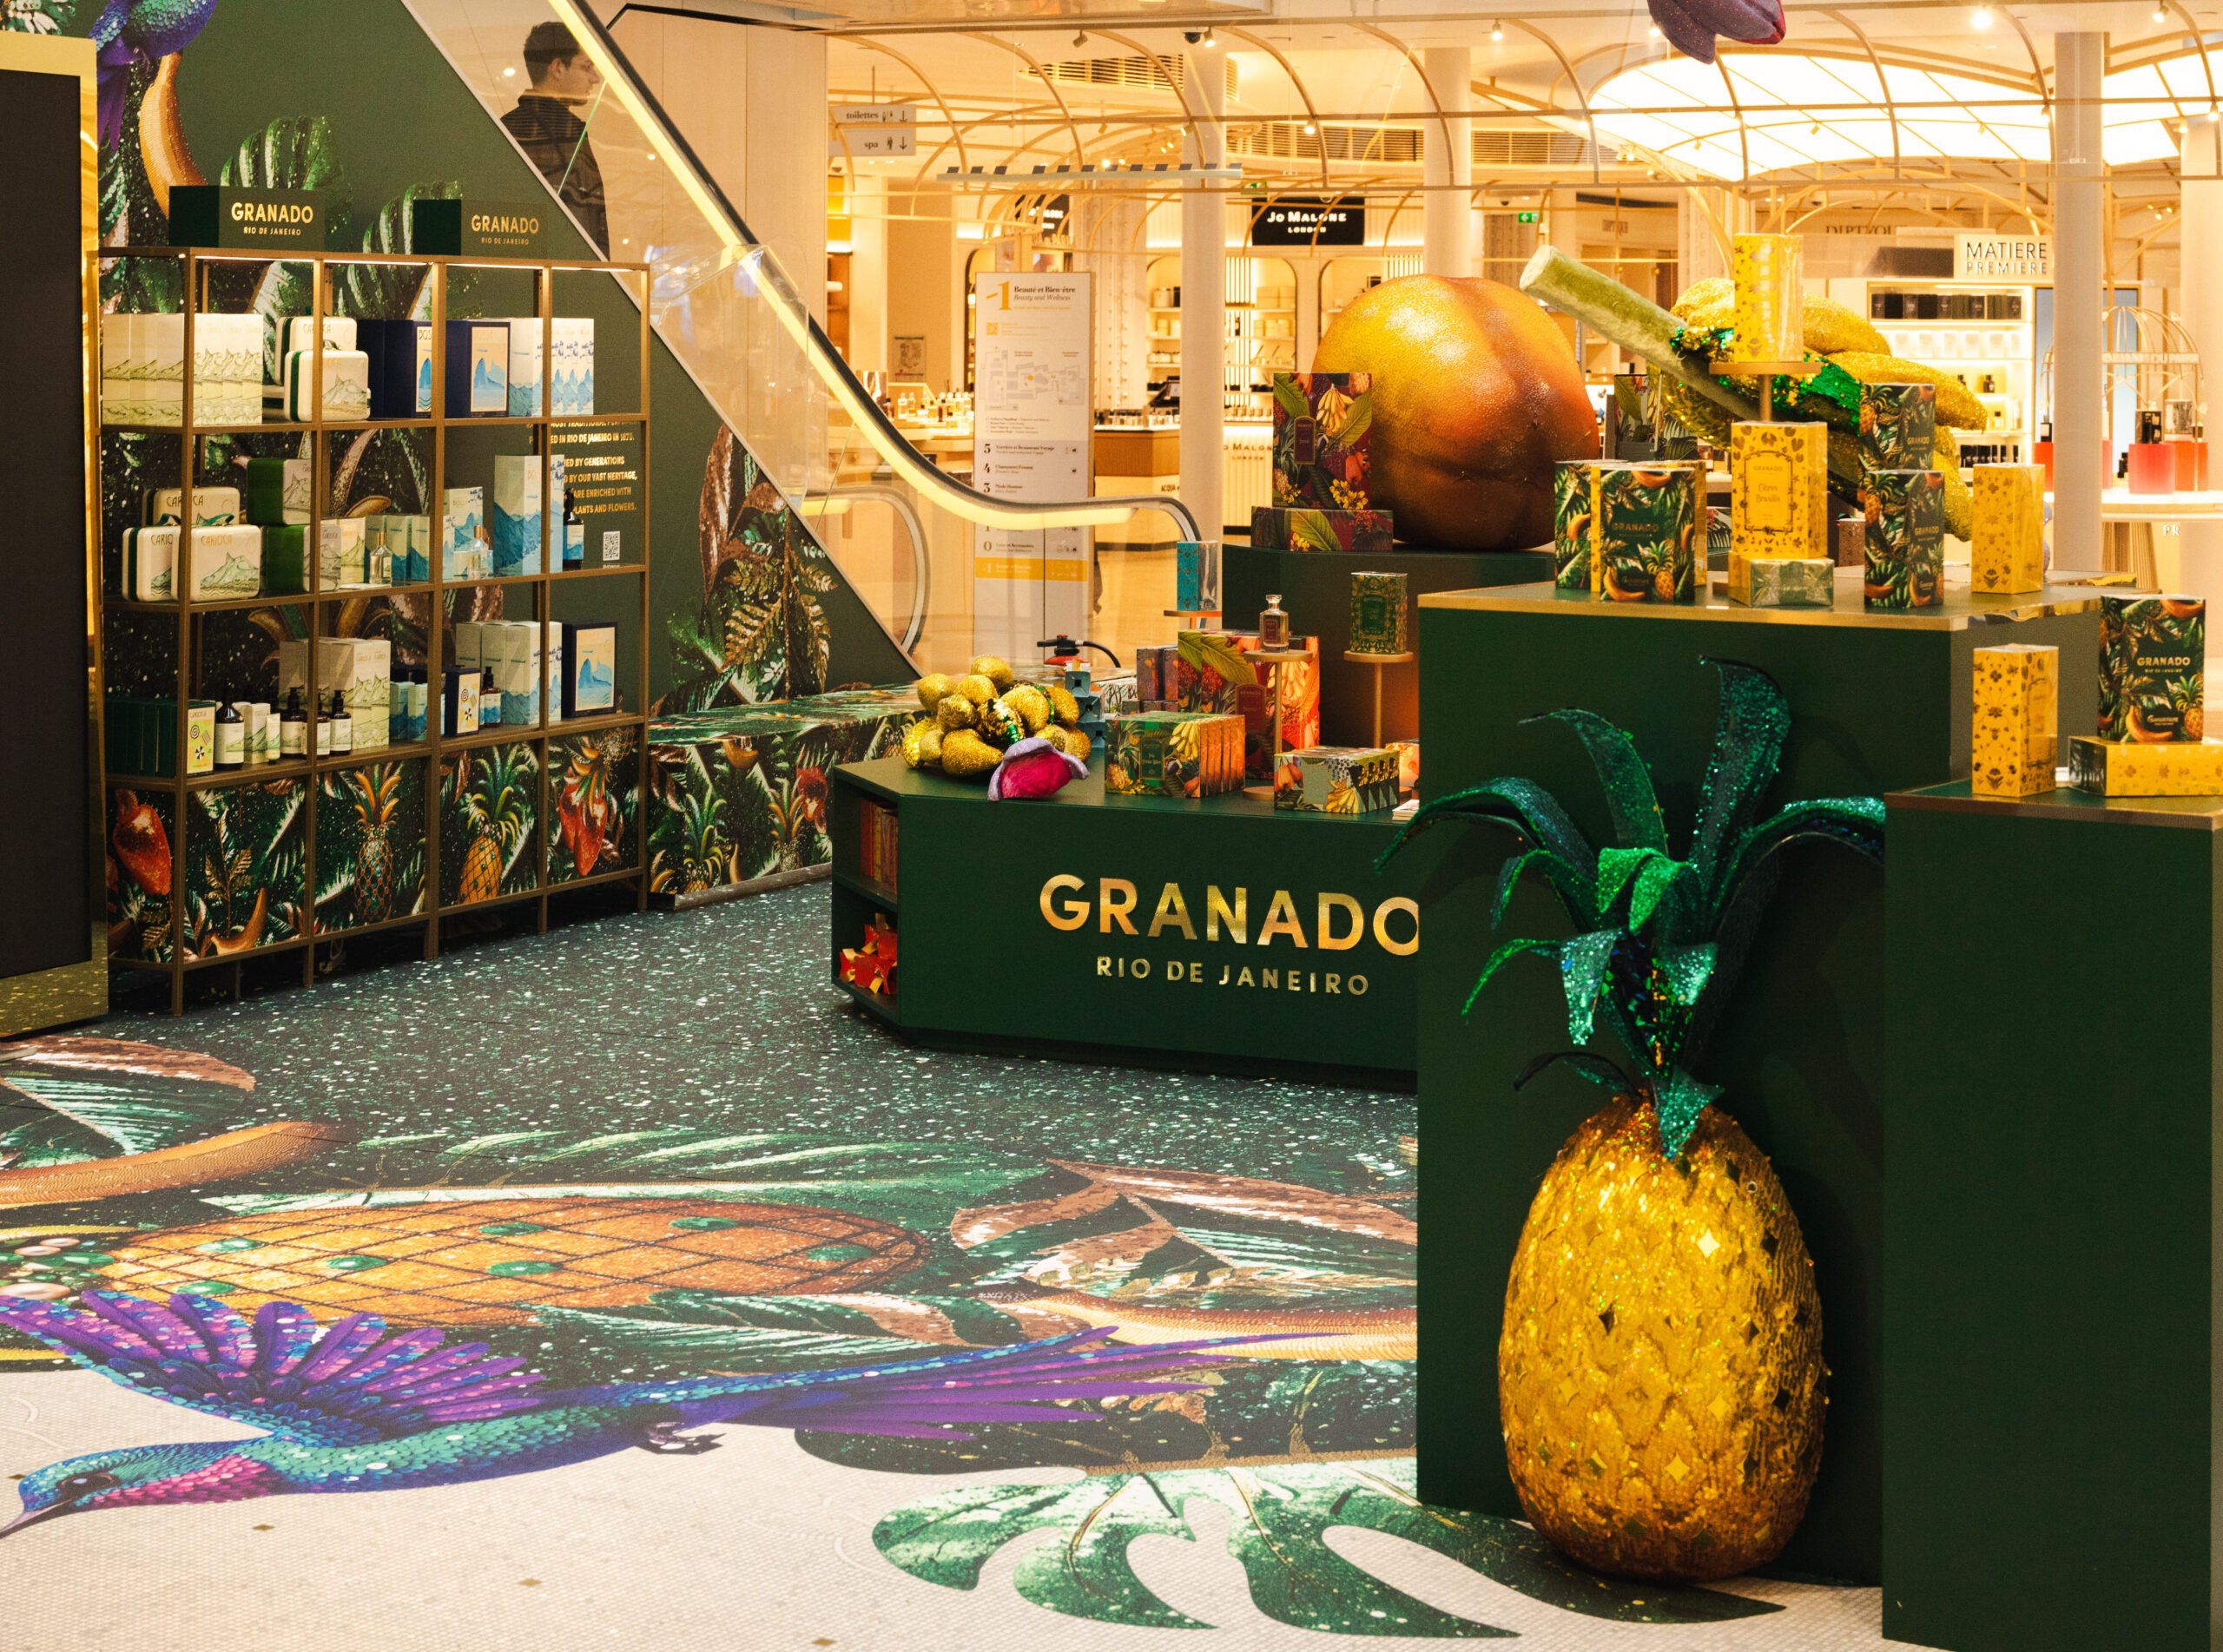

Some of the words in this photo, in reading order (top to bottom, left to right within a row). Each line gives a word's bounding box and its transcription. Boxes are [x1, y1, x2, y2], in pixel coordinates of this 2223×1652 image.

[846, 110, 879, 119] toilettes
[864, 142, 879, 150] spa
[231, 201, 313, 224] GRANADO
[471, 214, 539, 234] GRANADO
[243, 226, 257, 234] RIO
[258, 227, 268, 235] DE
[269, 227, 301, 236] JANEIRO
[1966, 241, 2047, 260] MATIERE
[1966, 261, 2047, 275] PREMIERE
[567, 434, 578, 444] RIO
[579, 433, 587, 443] DE
[587, 432, 612, 444] JANEIRO
[612, 433, 619, 442] IN
[983, 444, 991, 454] 5
[575, 457, 584, 467] BY
[584, 456, 625, 466] GENERATIONS
[983, 463, 991, 473] 4
[569, 474, 577, 483] BY
[577, 473, 591, 483] OUR
[591, 472, 606, 482] VAST
[607, 471, 637, 481] HERITAGE,
[574, 489, 584, 498] ARE
[586, 487, 616, 497] ENRICHED
[616, 486, 632, 496] WITH
[594, 504, 607, 514] AND
[607, 502, 636, 513] FLOWERS.
[1613, 523, 1659, 532] GRANADO
[201, 534, 233, 546] CARIOCA
[2136, 656, 2191, 667] GRANADO
[1039, 873, 1419, 956] GRANADO
[1097, 956, 1151, 980] RIO
[1167, 961, 1204, 984] DE
[1218, 964, 1369, 996] JANEIRO
